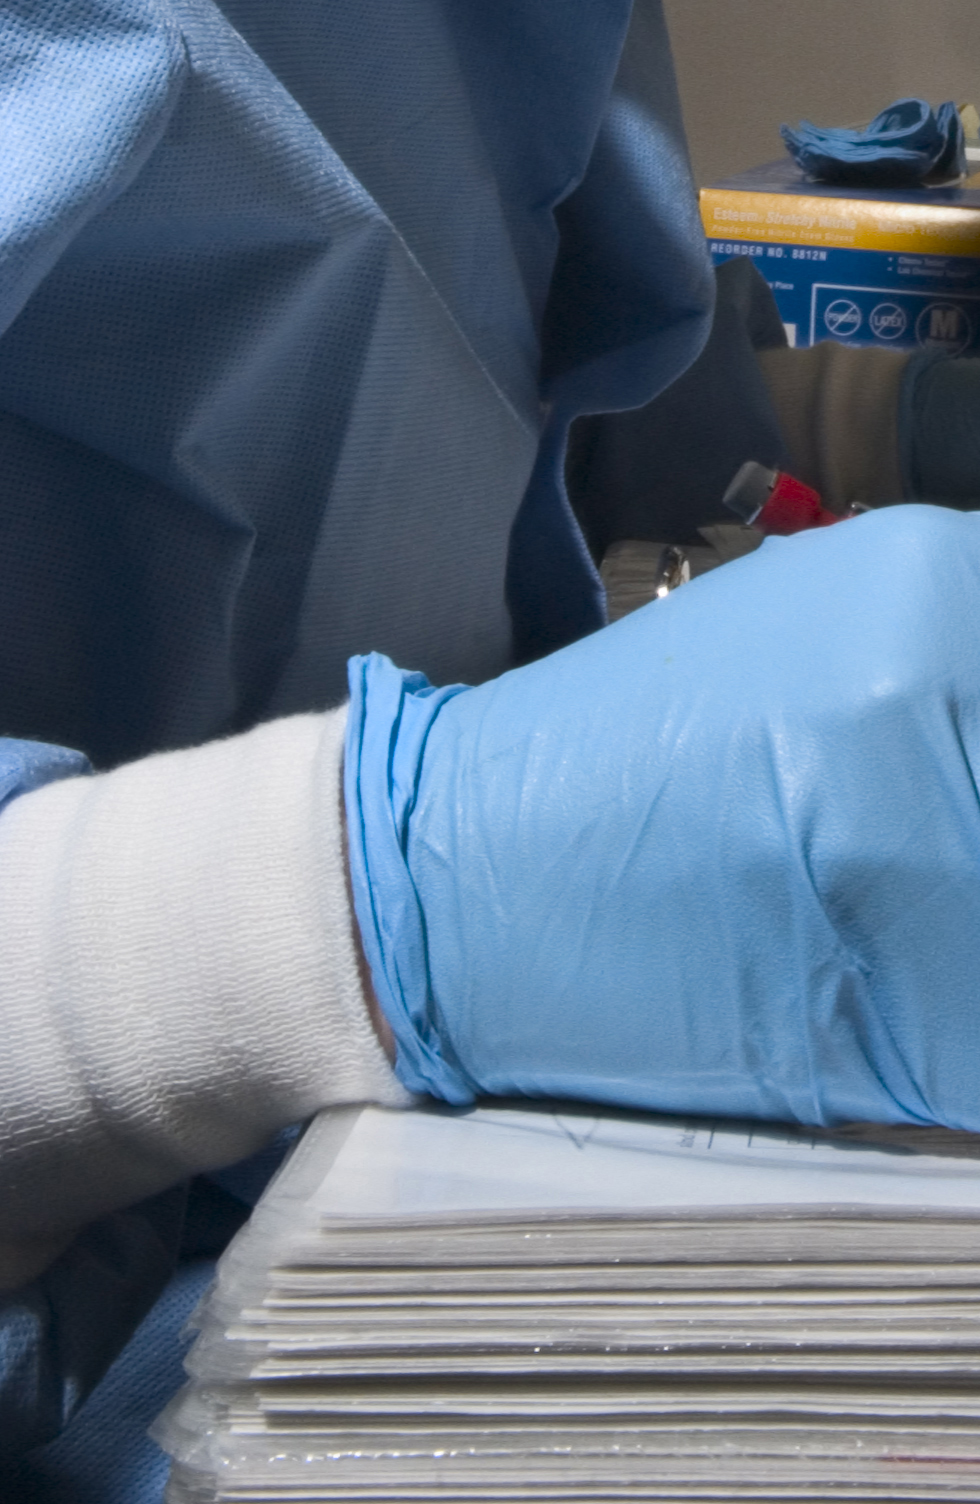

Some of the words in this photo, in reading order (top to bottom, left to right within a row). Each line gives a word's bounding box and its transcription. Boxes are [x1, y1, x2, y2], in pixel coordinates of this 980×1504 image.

[765, 211, 816, 229] Stretchy
[818, 215, 857, 230] Nitrile
[711, 242, 763, 257] REORDER
[767, 247, 788, 259] NO.
[792, 248, 827, 262] 8812N
[873, 315, 904, 328] LATEX
[930, 309, 959, 339] M
